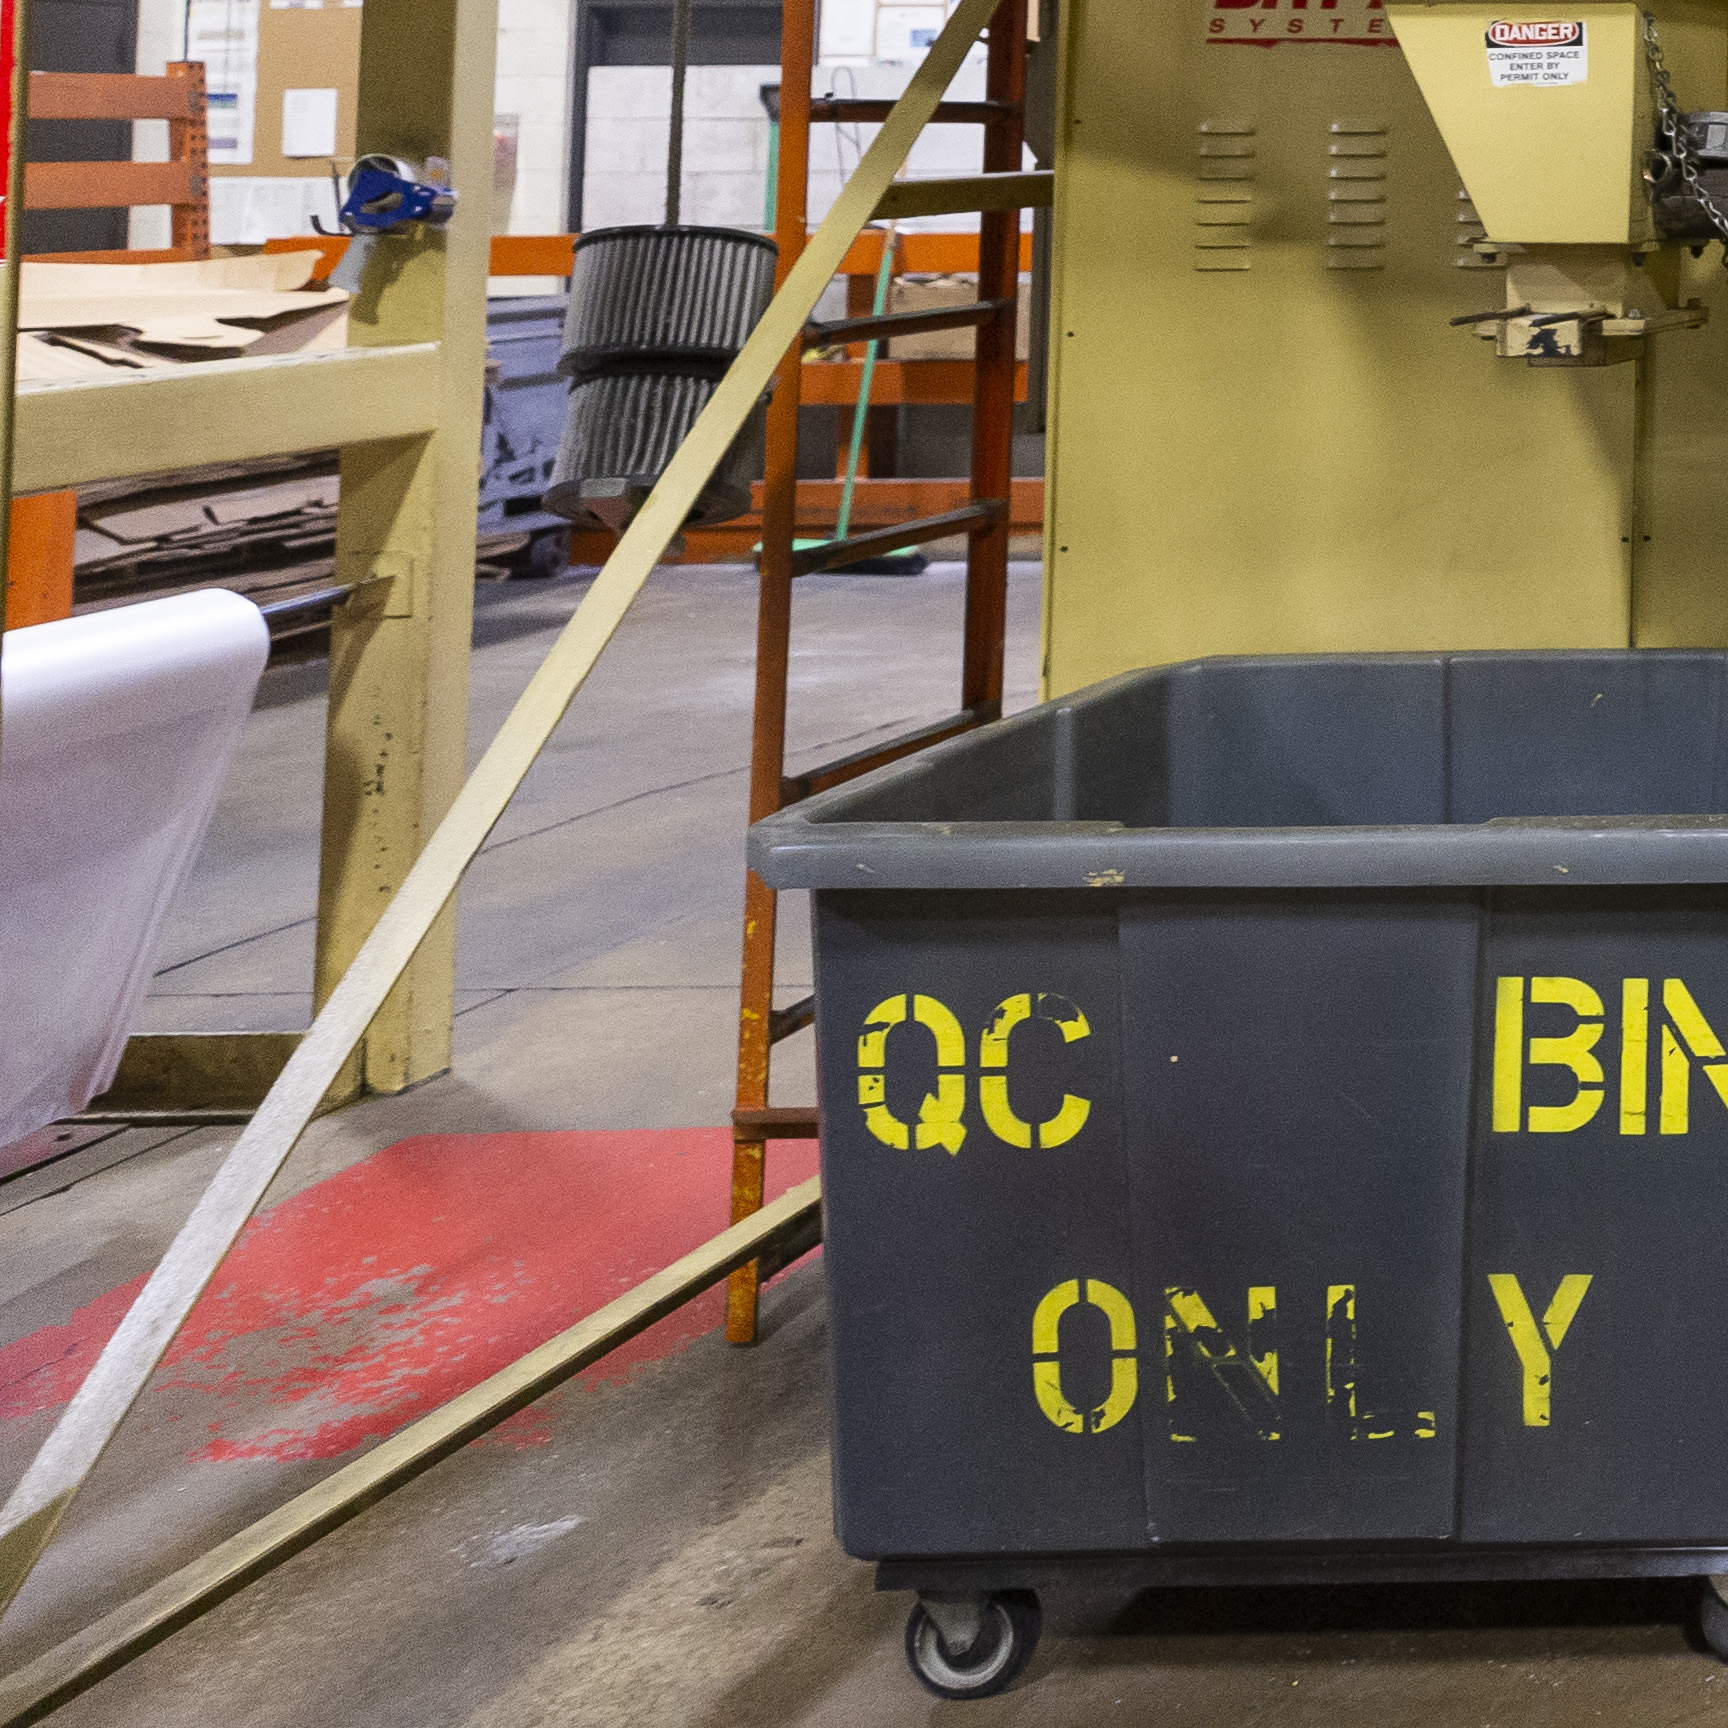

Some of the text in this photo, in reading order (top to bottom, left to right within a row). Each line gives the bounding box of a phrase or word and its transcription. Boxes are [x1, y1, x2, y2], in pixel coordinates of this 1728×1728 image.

[1494, 23, 1574, 41] DANGER
[1488, 50, 1580, 61] CONFINED SPACE
[1509, 62, 1560, 71] ENTER BY
[1500, 72, 1570, 81] PERMIT ONLY
[857, 992, 1091, 1156] QC
